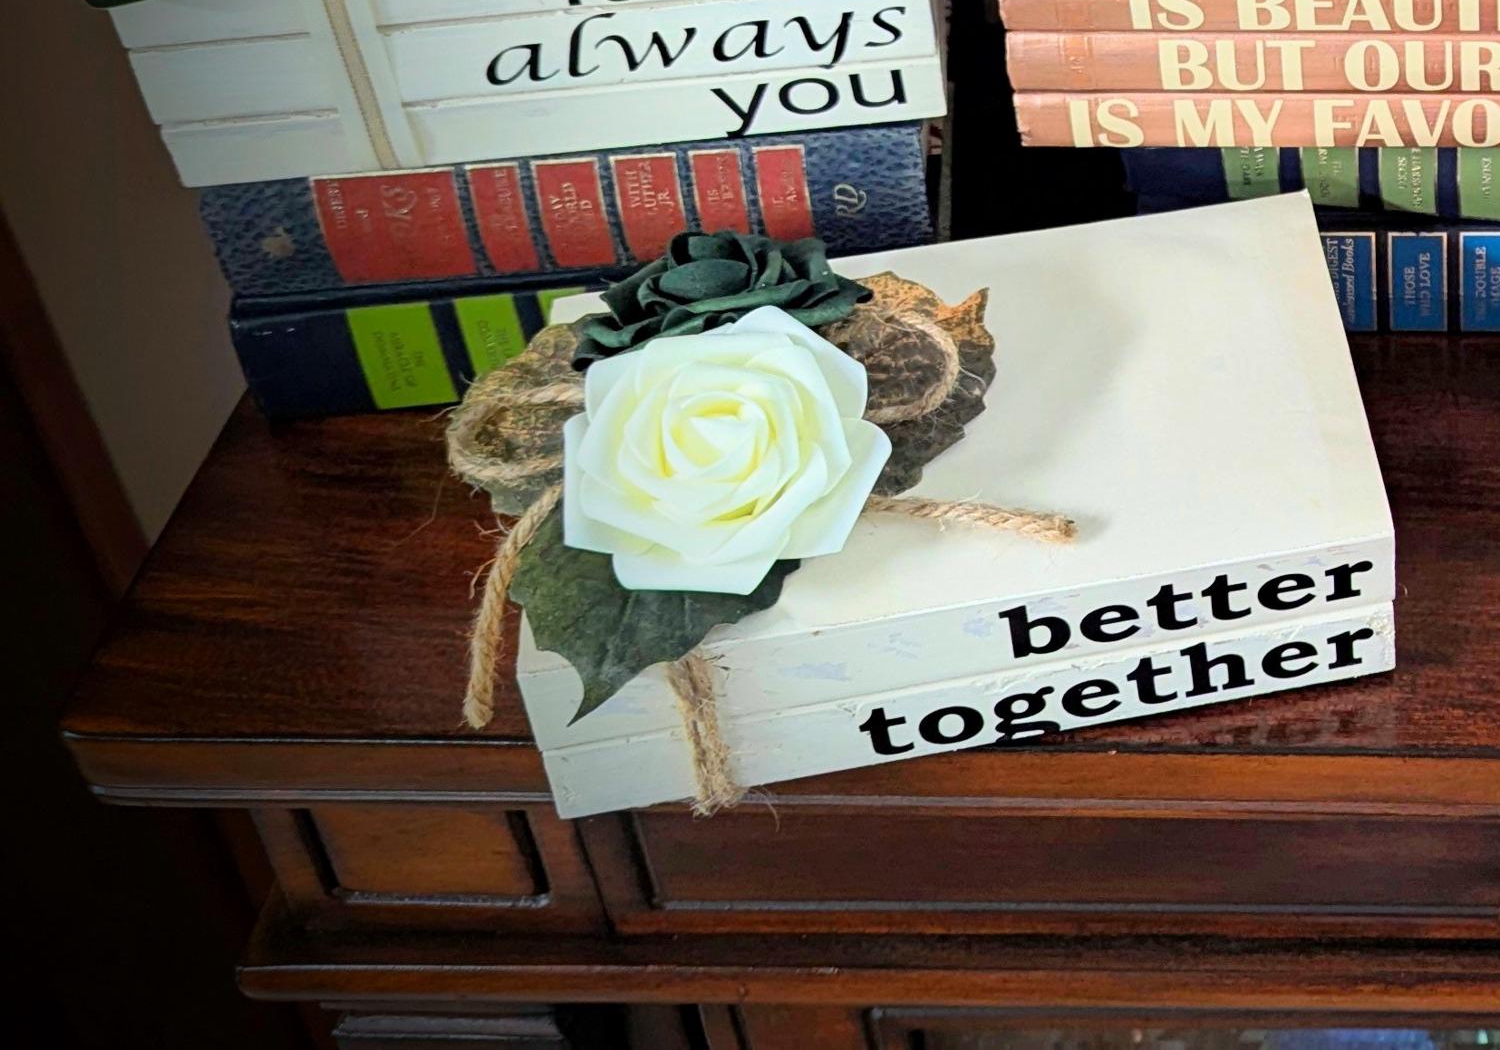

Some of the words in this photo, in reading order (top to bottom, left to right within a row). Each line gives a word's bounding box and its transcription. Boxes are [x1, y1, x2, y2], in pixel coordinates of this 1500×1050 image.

[486, 5, 907, 86] always
[1158, 39, 1316, 92] BUT
[710, 68, 908, 138] you
[1068, 100, 1144, 148] IS
[1174, 99, 1285, 148] MY
[1418, 253, 1431, 287] LOVE
[998, 560, 1374, 659] better
[859, 627, 1375, 756] together
